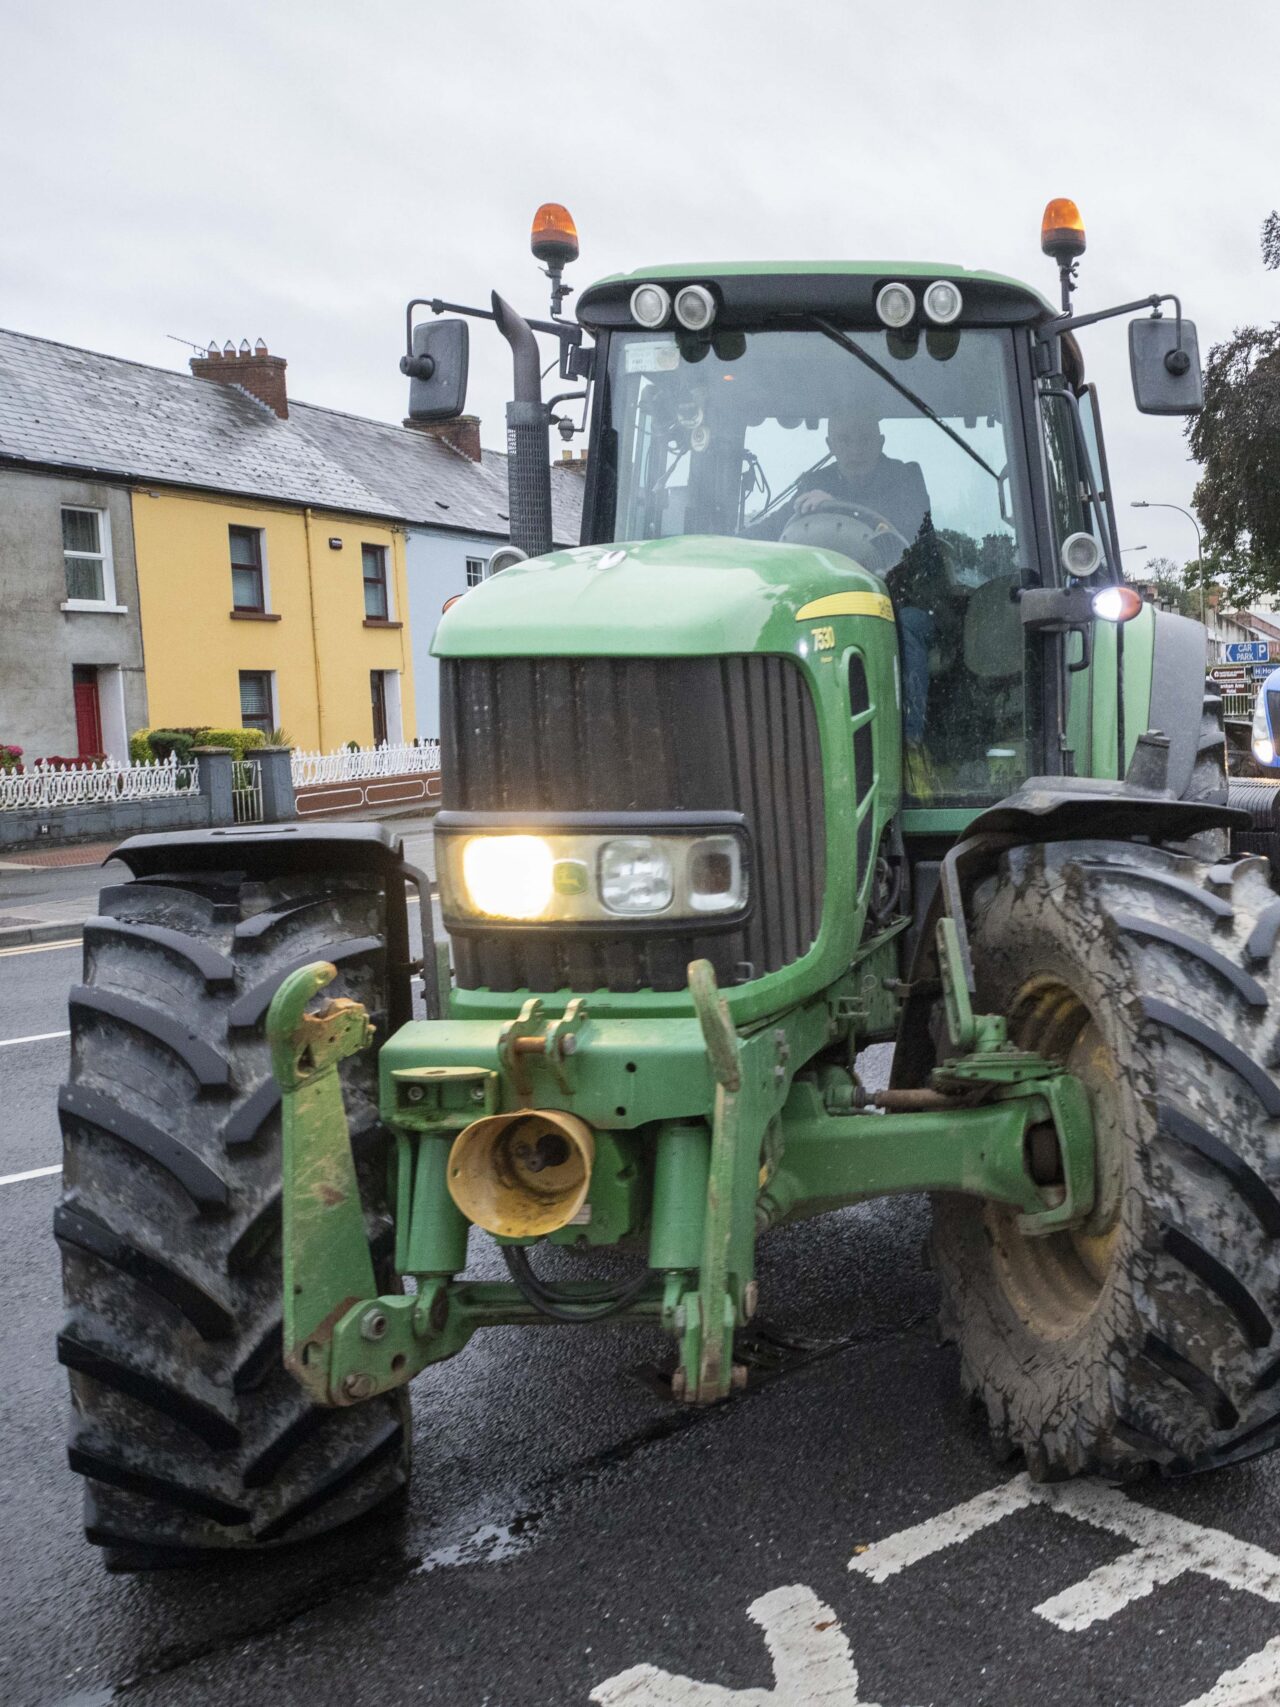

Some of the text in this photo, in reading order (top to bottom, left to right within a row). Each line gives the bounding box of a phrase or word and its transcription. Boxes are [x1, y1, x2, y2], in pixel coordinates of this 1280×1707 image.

[811, 626, 835, 652] 7530
[1238, 644, 1252, 653] CAR
[1259, 645, 1267, 657] P
[1236, 653, 1254, 661] PARK
